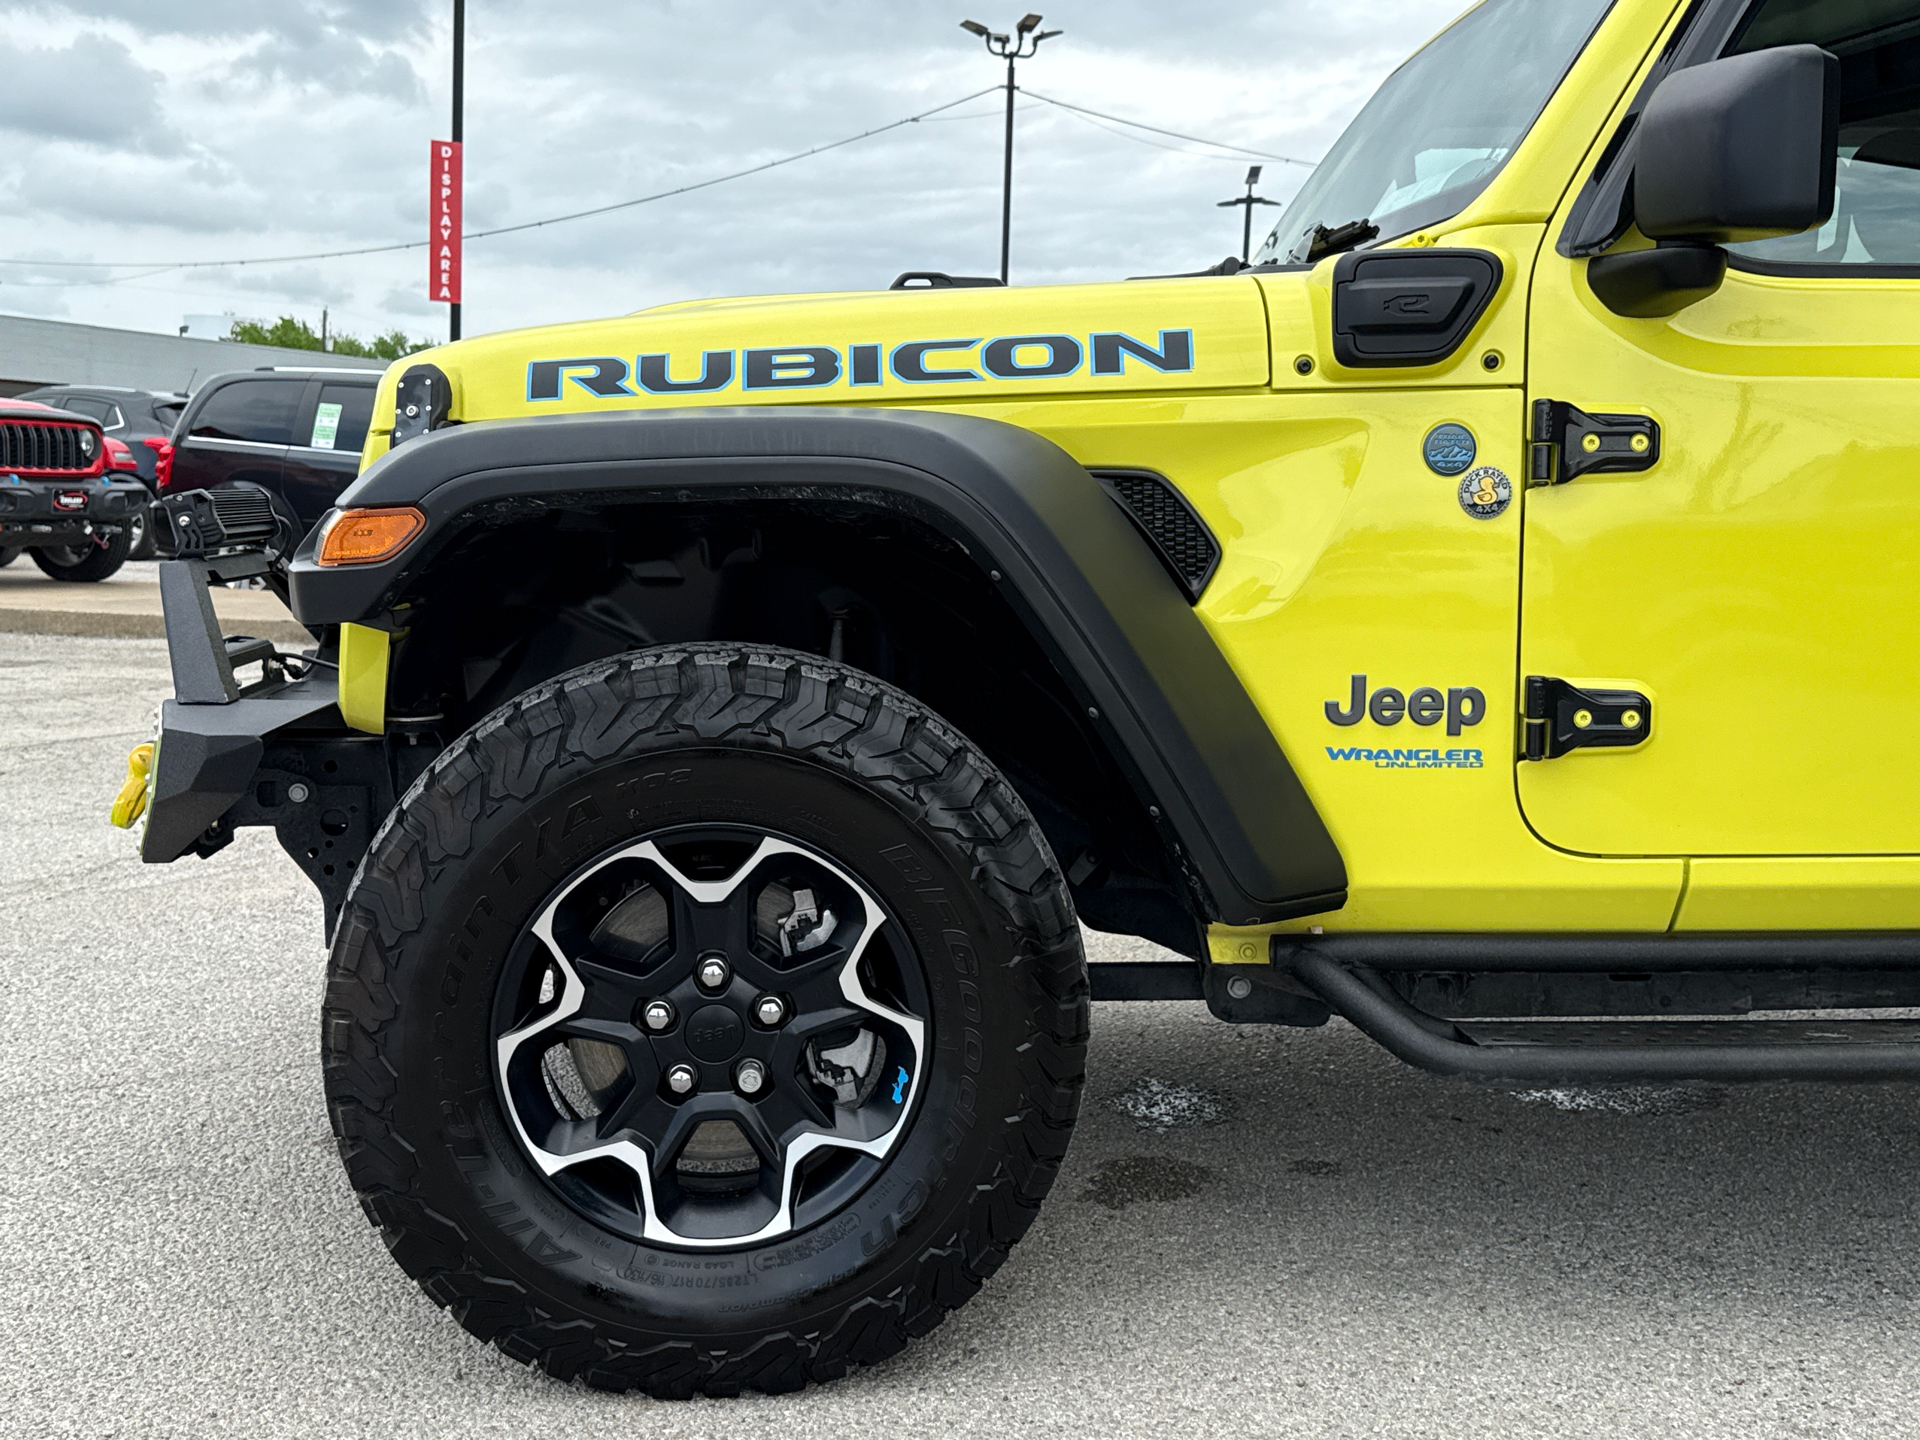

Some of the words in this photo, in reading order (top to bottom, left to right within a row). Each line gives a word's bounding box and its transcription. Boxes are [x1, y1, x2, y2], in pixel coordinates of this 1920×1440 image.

[440, 145, 452, 240] DISPLAY
[439, 245, 452, 298] AREA
[526, 328, 1194, 402] RUBICON
[1463, 472, 1482, 494] DUCK
[1483, 470, 1508, 490] RATED
[1476, 504, 1498, 514] 4X4
[1324, 674, 1486, 736] Jeep
[1325, 746, 1483, 761] WRANGLER
[615, 768, 692, 799] KO2
[693, 1024, 737, 1043] Jeep
[859, 843, 984, 1257] BFGoodrich
